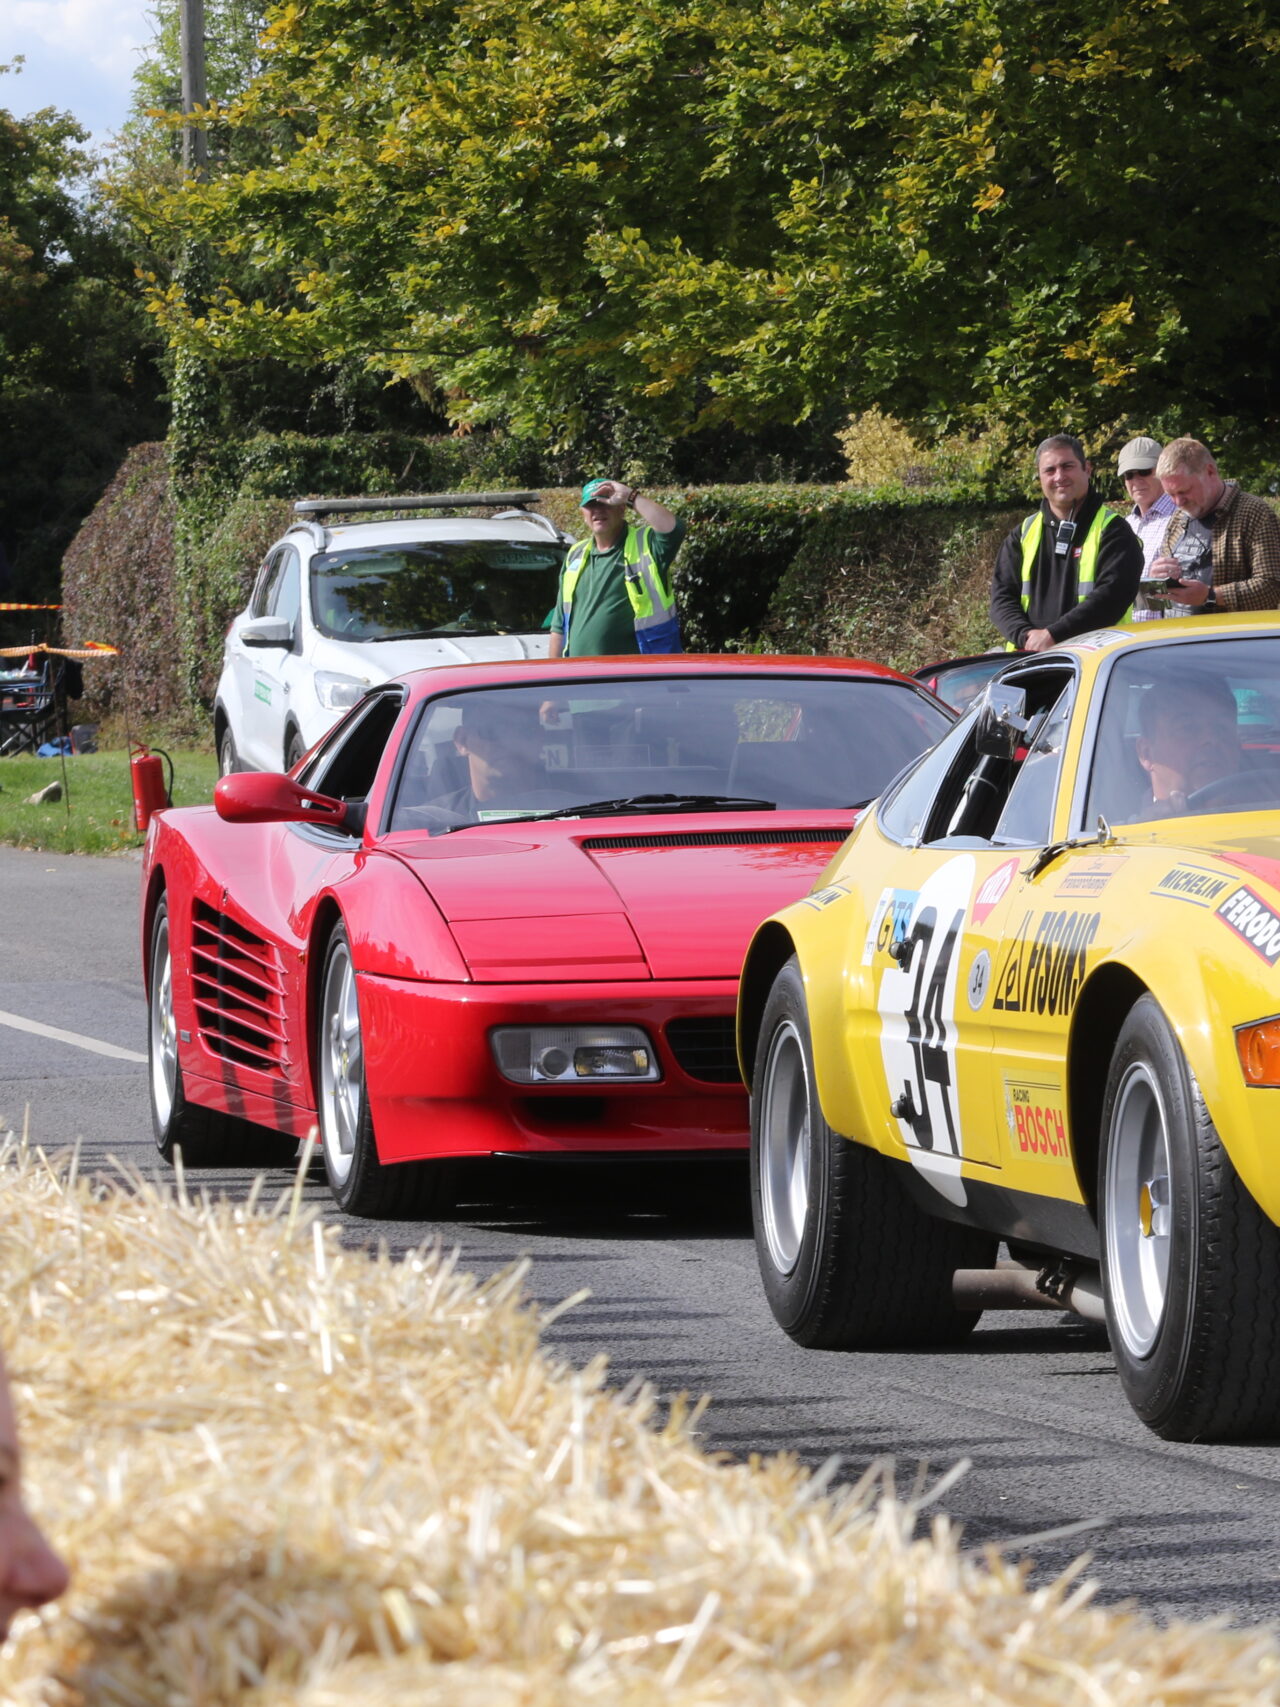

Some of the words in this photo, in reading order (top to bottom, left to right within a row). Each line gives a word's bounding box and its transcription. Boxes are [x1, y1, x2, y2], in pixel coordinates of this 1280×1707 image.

[1158, 869, 1228, 899] MICHELIN
[972, 963, 984, 994] 34
[1022, 910, 1101, 1016] FISONS
[903, 905, 966, 1157] 34
[1012, 1088, 1030, 1103] RACING
[1014, 1104, 1069, 1158] BOSCH
